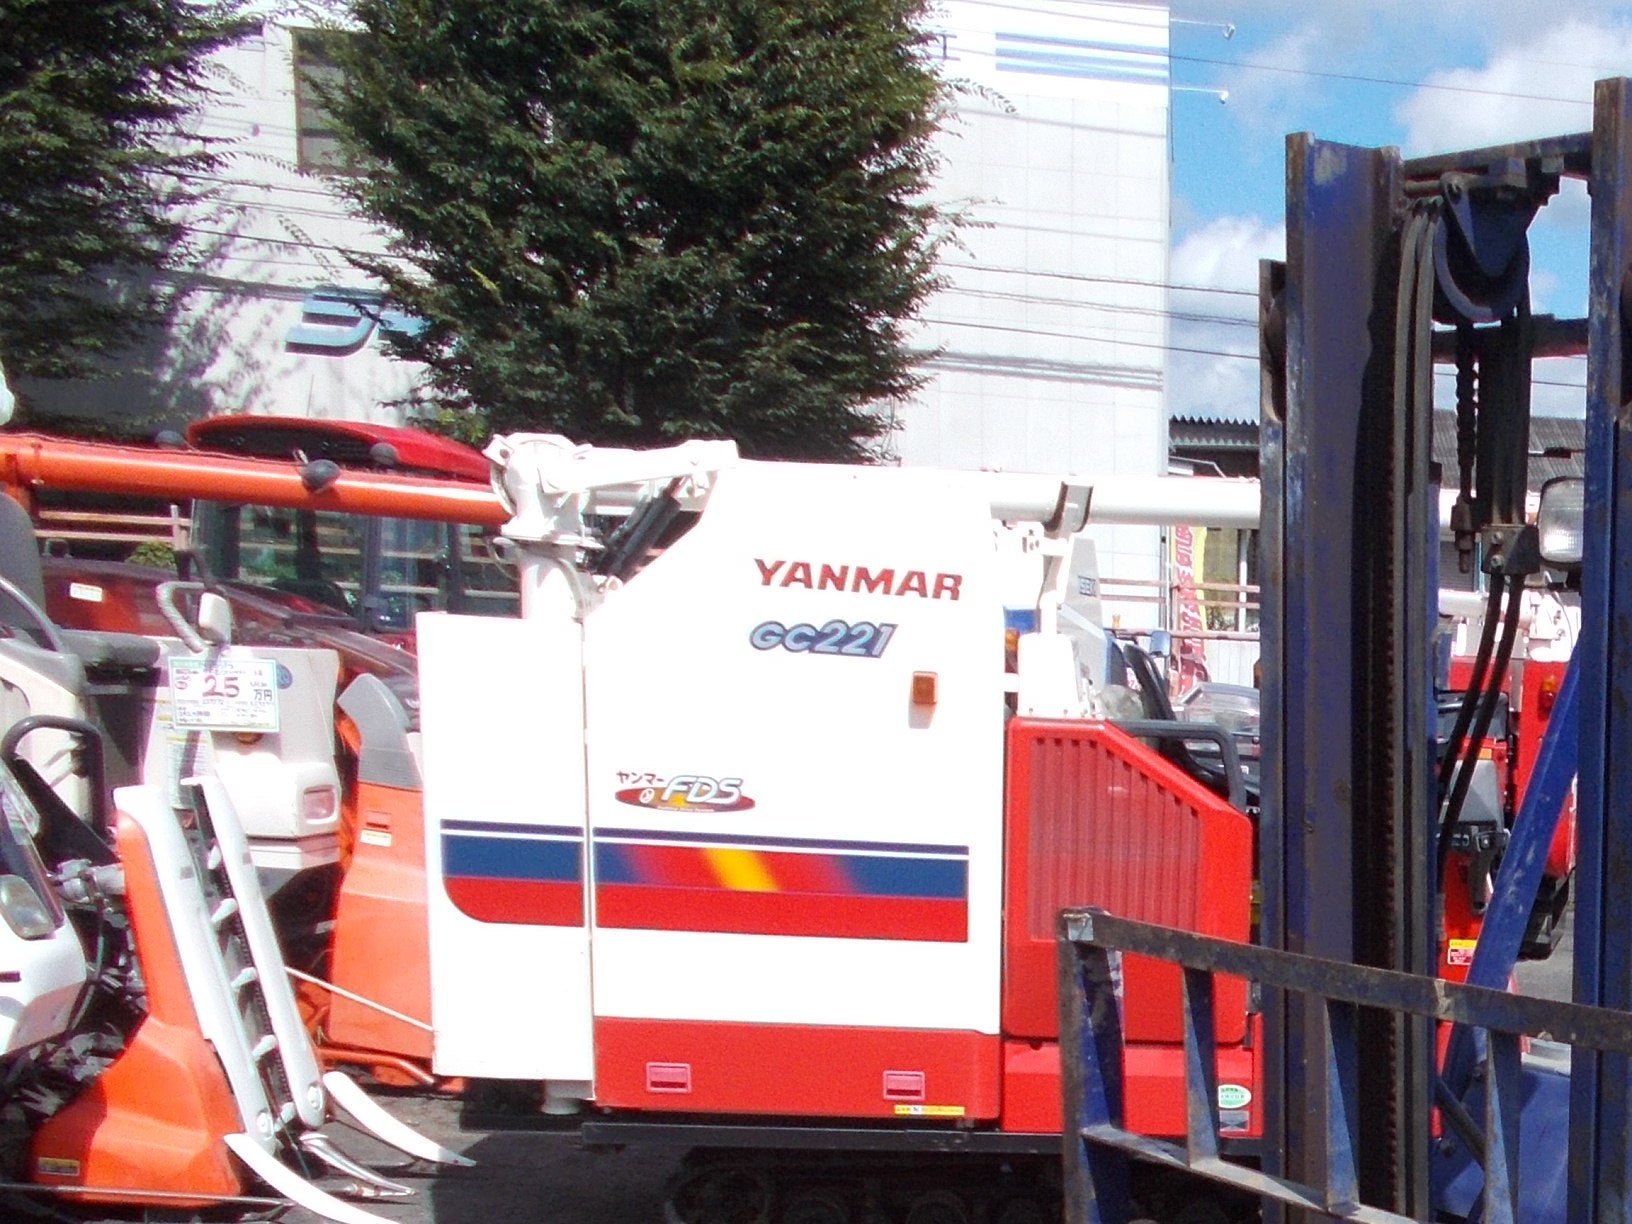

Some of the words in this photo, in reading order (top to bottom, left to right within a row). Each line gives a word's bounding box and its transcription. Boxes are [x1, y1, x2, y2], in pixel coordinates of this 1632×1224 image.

[754, 558, 963, 601] YANMAR
[749, 619, 899, 658] GC221
[202, 675, 240, 698] 25
[616, 771, 665, 785] ヤンマー
[661, 774, 744, 805] FDS
